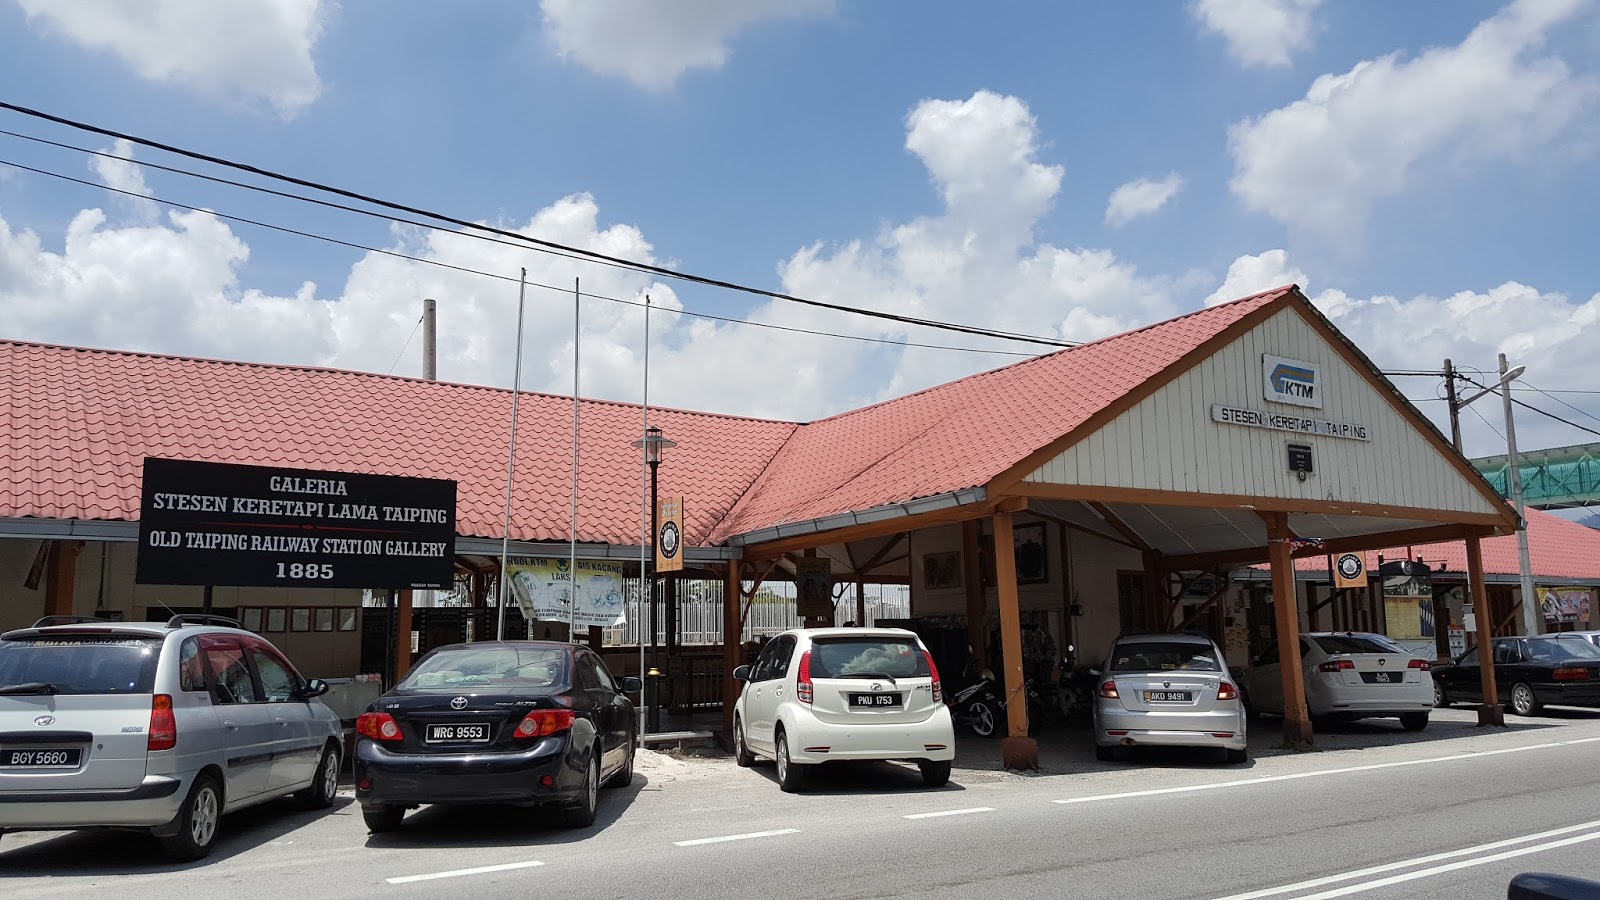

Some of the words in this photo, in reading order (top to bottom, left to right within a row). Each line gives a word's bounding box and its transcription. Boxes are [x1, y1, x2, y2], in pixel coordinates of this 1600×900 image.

[1285, 381, 1314, 399] KTM
[1222, 408, 1262, 425] STESEN
[1269, 414, 1318, 433] KERETAPI
[1326, 422, 1366, 439] TAIPING
[270, 475, 348, 496] GALERIA
[153, 492, 227, 513] STESEN
[233, 497, 323, 518] KERETAPI
[328, 503, 379, 521] LAMA
[383, 506, 447, 524] TAIPING
[150, 530, 181, 548] OLD
[185, 532, 247, 550] TAIPING
[251, 536, 320, 553] RAILWAY
[322, 538, 382, 556] STATION
[385, 540, 447, 557] GALLERY
[530, 558, 548, 567] KTM
[578, 562, 591, 570] AIS
[592, 564, 622, 574] KACANG
[276, 562, 334, 579] 1885
[552, 572, 576, 581] LAKS
[858, 696, 873, 705] PKU
[876, 696, 893, 705] 1753
[1151, 692, 1166, 700] AKD
[1167, 692, 1185, 700] 9491
[433, 726, 454, 739] WRG
[457, 726, 483, 738] 9553
[11, 752, 35, 764] BGY
[36, 752, 68, 764] 5660
